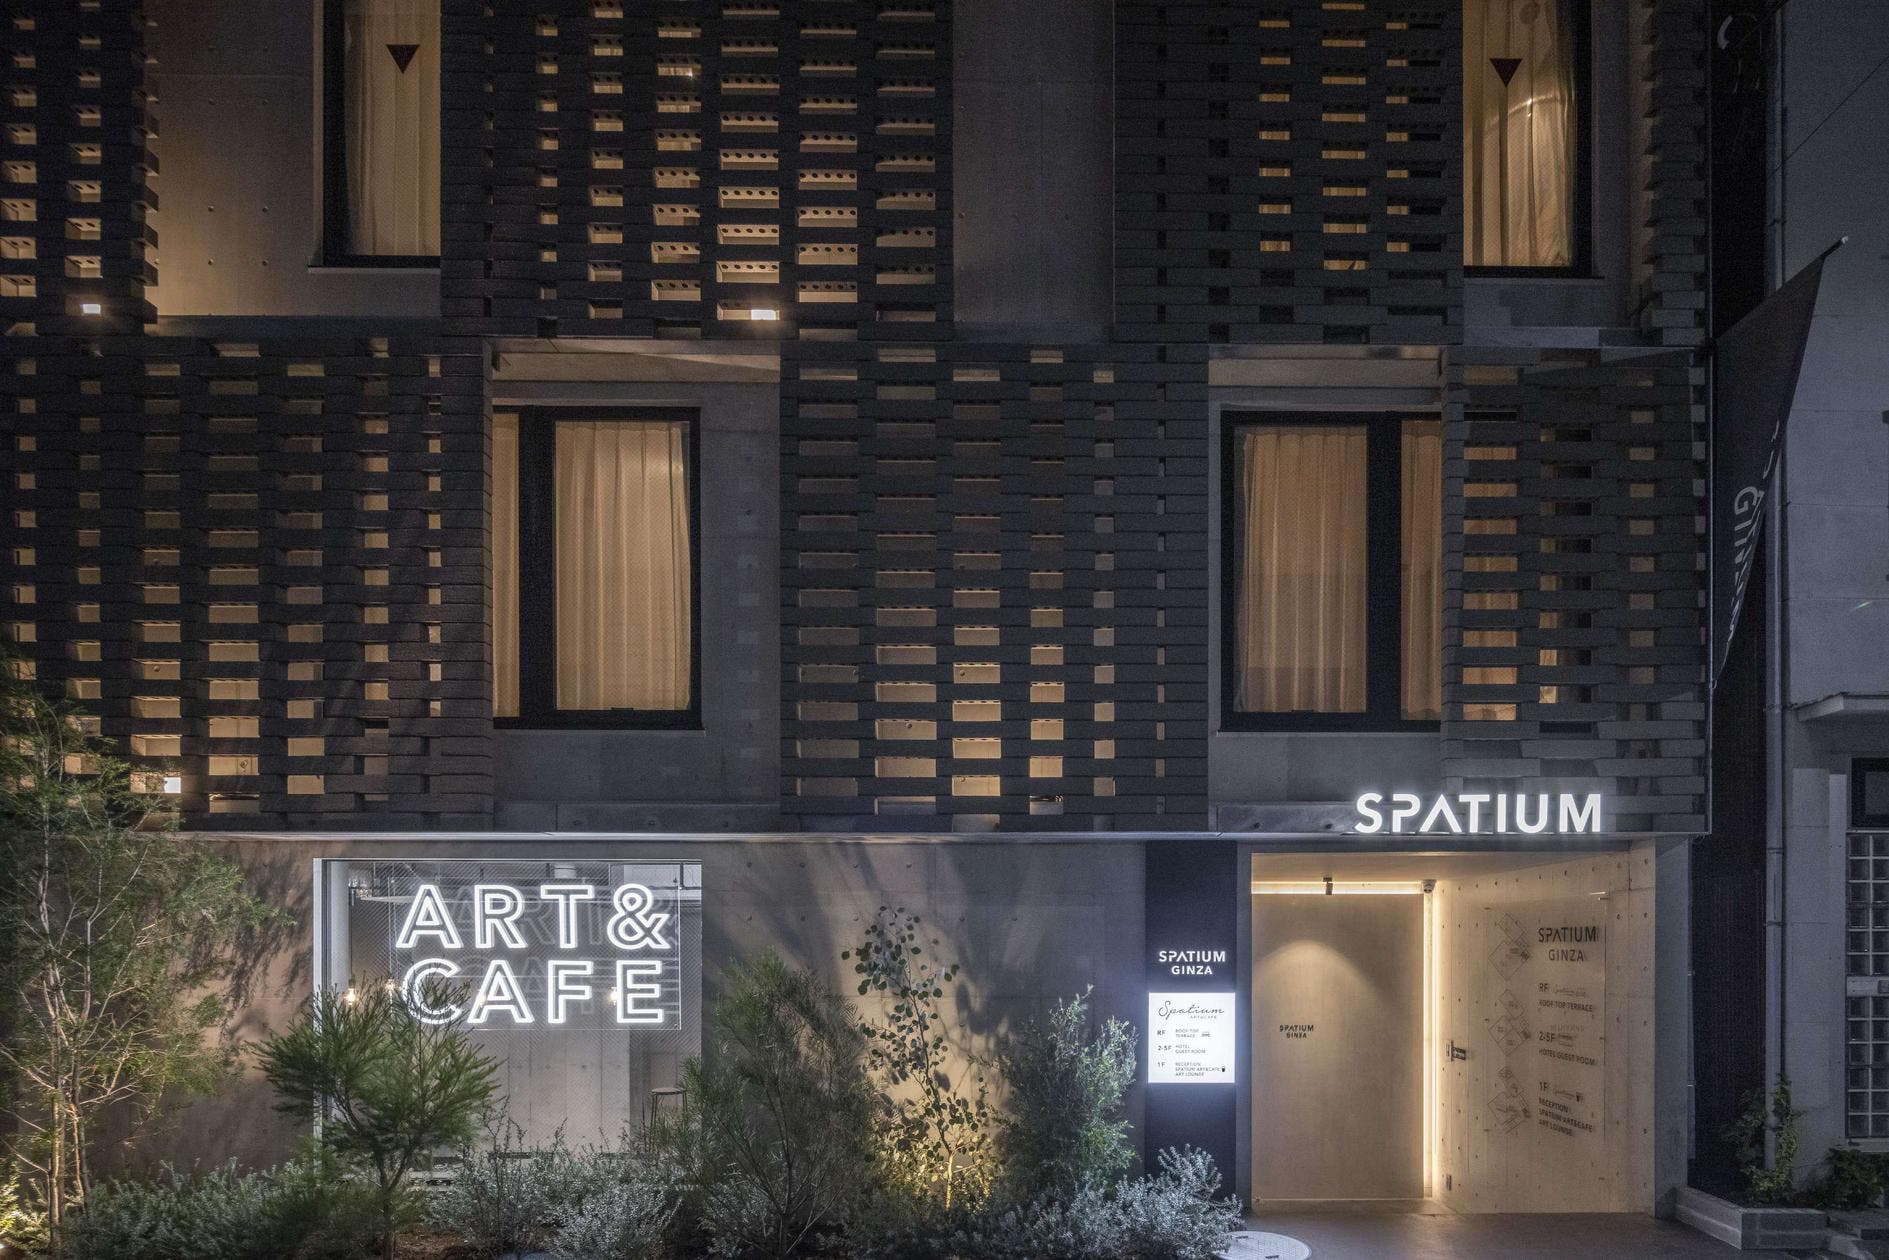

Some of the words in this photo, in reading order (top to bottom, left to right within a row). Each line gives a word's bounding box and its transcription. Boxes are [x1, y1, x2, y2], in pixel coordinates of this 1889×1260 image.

[1354, 792, 1602, 834] SPATIUM
[395, 883, 672, 950] ART&
[1538, 926, 1597, 943] SPATIUM
[1158, 950, 1226, 962] SPATIUM
[1548, 948, 1585, 962] GINZA
[1171, 965, 1214, 975] GINZA
[401, 957, 665, 1025] CAFE
[1539, 982, 1549, 993] RF
[1158, 1000, 1225, 1020] Spatium
[1279, 1024, 1314, 1032] SPATIUM
